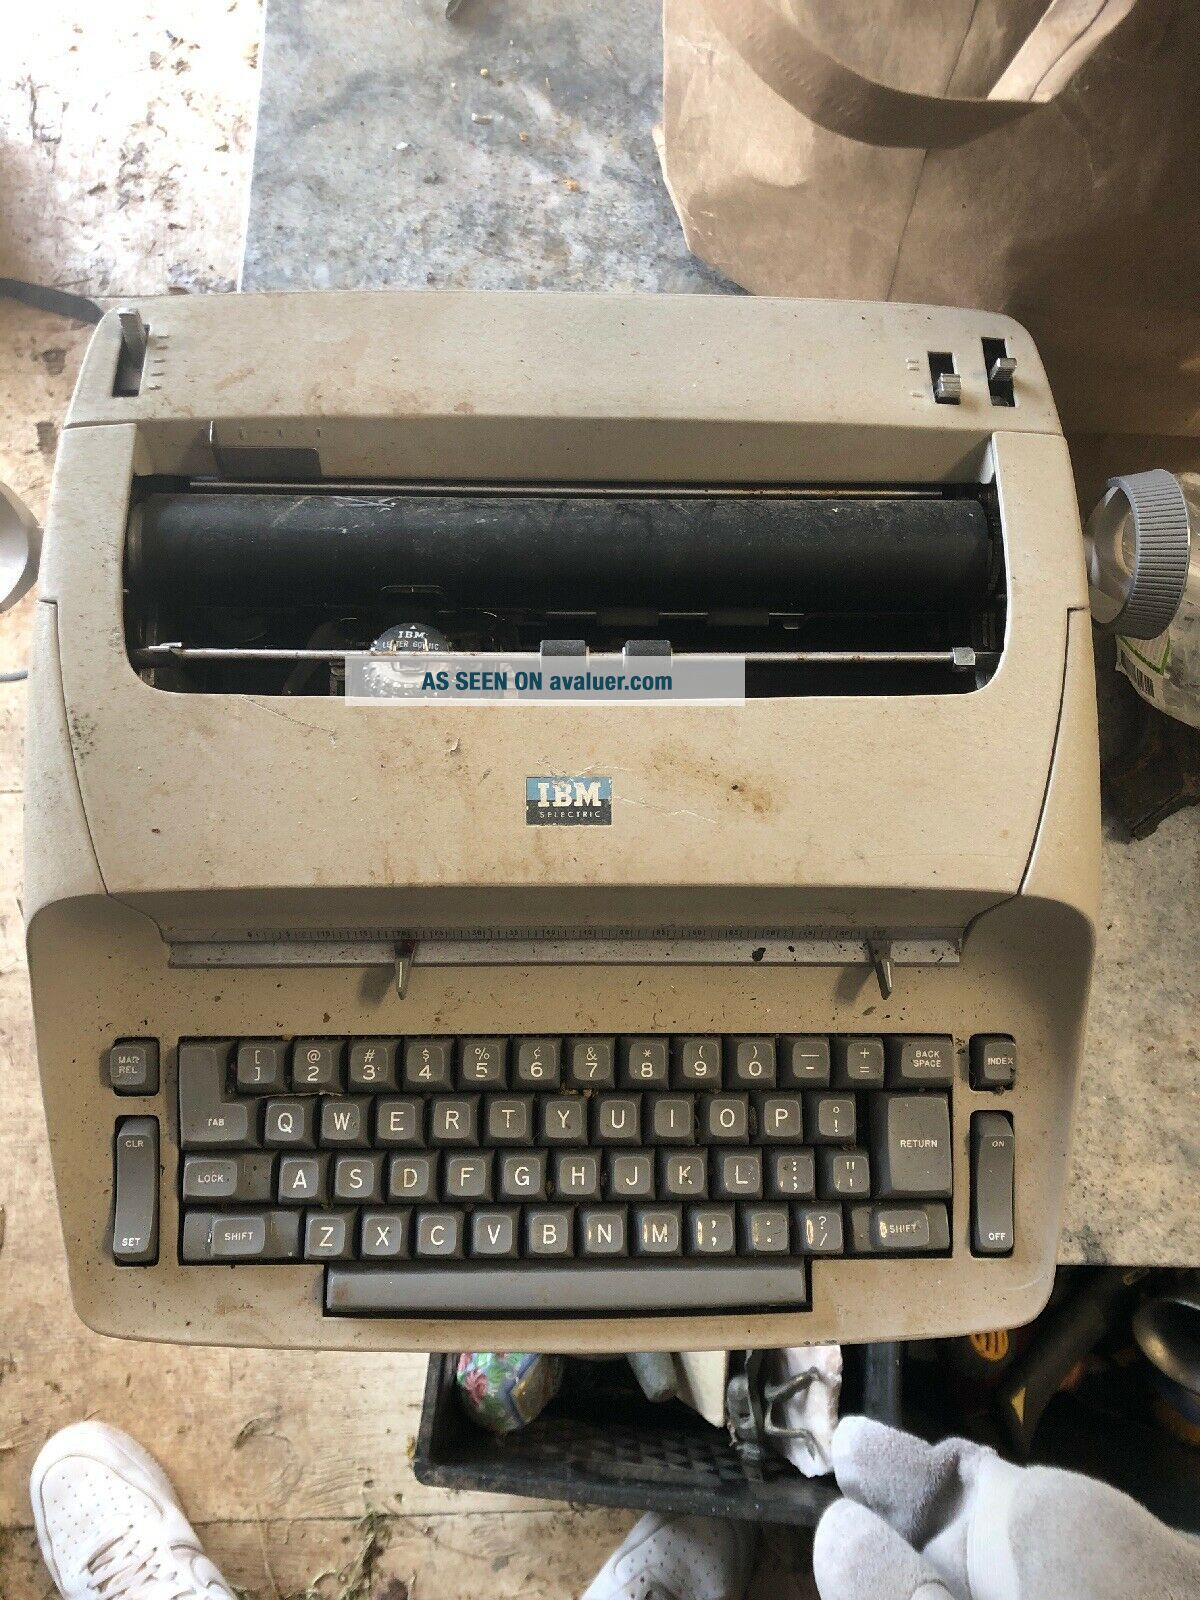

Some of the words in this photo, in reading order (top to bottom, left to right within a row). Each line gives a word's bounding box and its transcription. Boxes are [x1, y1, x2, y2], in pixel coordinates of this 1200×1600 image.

[397, 631, 426, 639] IBM
[382, 640, 409, 649] LETER
[538, 781, 602, 807] IBM
[307, 1050, 321, 1063] @
[364, 1049, 375, 1062] #
[422, 1050, 430, 1063] $
[475, 1048, 490, 1060] %
[586, 1046, 598, 1061] &
[698, 1046, 703, 1058] (
[752, 1046, 758, 1058] )
[860, 1048, 870, 1058] +
[916, 1050, 940, 1059] BACK
[118, 1056, 140, 1064] MAR
[913, 1059, 941, 1068] SPACE
[987, 1057, 1014, 1065] INDEX
[119, 1066, 138, 1074] REL
[307, 1067, 320, 1082] 2
[362, 1065, 375, 1080] 3
[418, 1065, 432, 1080] 4
[476, 1063, 488, 1078] 5
[530, 1062, 543, 1077] 6
[585, 1062, 598, 1077] 7
[641, 1062, 653, 1077] 8
[694, 1061, 707, 1076] 9
[749, 1061, 762, 1077] 0
[208, 1118, 225, 1126] TAB
[277, 1113, 294, 1133] Q
[333, 1112, 350, 1131] W
[390, 1112, 404, 1131] E
[445, 1111, 459, 1130] R
[502, 1109, 515, 1128] T
[557, 1110, 570, 1129] Y
[611, 1109, 625, 1129] U
[719, 1108, 735, 1128] O
[775, 1108, 789, 1128] P
[834, 1119, 839, 1132] !
[125, 1139, 144, 1148] CLR
[900, 1139, 938, 1148] RETURN
[992, 1140, 1005, 1148] ON
[198, 1174, 224, 1183] LOCK
[292, 1170, 307, 1189] A
[349, 1168, 363, 1189] S
[403, 1168, 418, 1188] D
[460, 1167, 474, 1187] F
[514, 1167, 530, 1186] G
[571, 1166, 585, 1186] H
[625, 1166, 638, 1186] J
[679, 1165, 693, 1185] K
[735, 1165, 748, 1184] L
[818, 1216, 827, 1230] ?
[889, 1224, 916, 1234] SHIFT
[224, 1232, 254, 1241] SHIFT
[319, 1227, 334, 1247] Z
[375, 1226, 390, 1247] X
[430, 1225, 445, 1246] C
[487, 1225, 501, 1245] V
[542, 1225, 557, 1244] B
[597, 1224, 612, 1244] N
[652, 1224, 668, 1243] M
[819, 1233, 828, 1247] /
[988, 1232, 1006, 1241] OFF
[121, 1237, 141, 1247] SET
